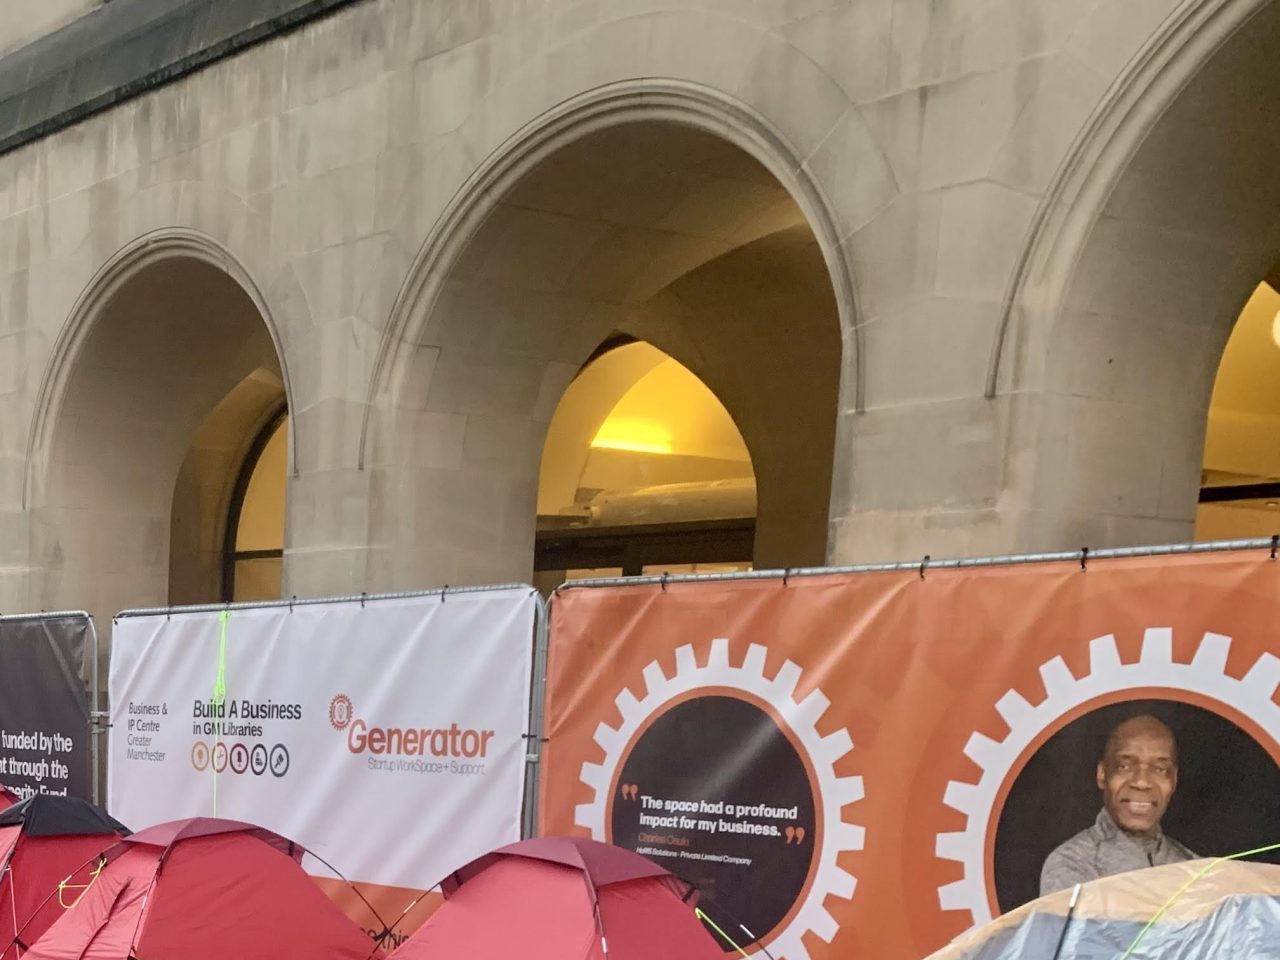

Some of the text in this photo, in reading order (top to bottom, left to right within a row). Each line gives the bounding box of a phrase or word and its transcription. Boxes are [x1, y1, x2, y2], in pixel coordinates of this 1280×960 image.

[128, 702, 168, 715] Business &
[193, 699, 302, 720] Build A Business
[136, 719, 160, 732] Centre
[192, 721, 263, 737] in GM Libraries
[1, 730, 38, 750] funded
[40, 731, 53, 755] by
[53, 732, 73, 752] the
[127, 733, 152, 746] Greater
[347, 719, 495, 758] Generator
[127, 748, 166, 761] Manchester
[8, 757, 49, 781] through
[51, 759, 69, 779] the
[367, 757, 396, 772] Startup
[450, 760, 486, 776] Support
[640, 795, 798, 819] The space had a profound
[639, 813, 782, 837] impact for my business.
